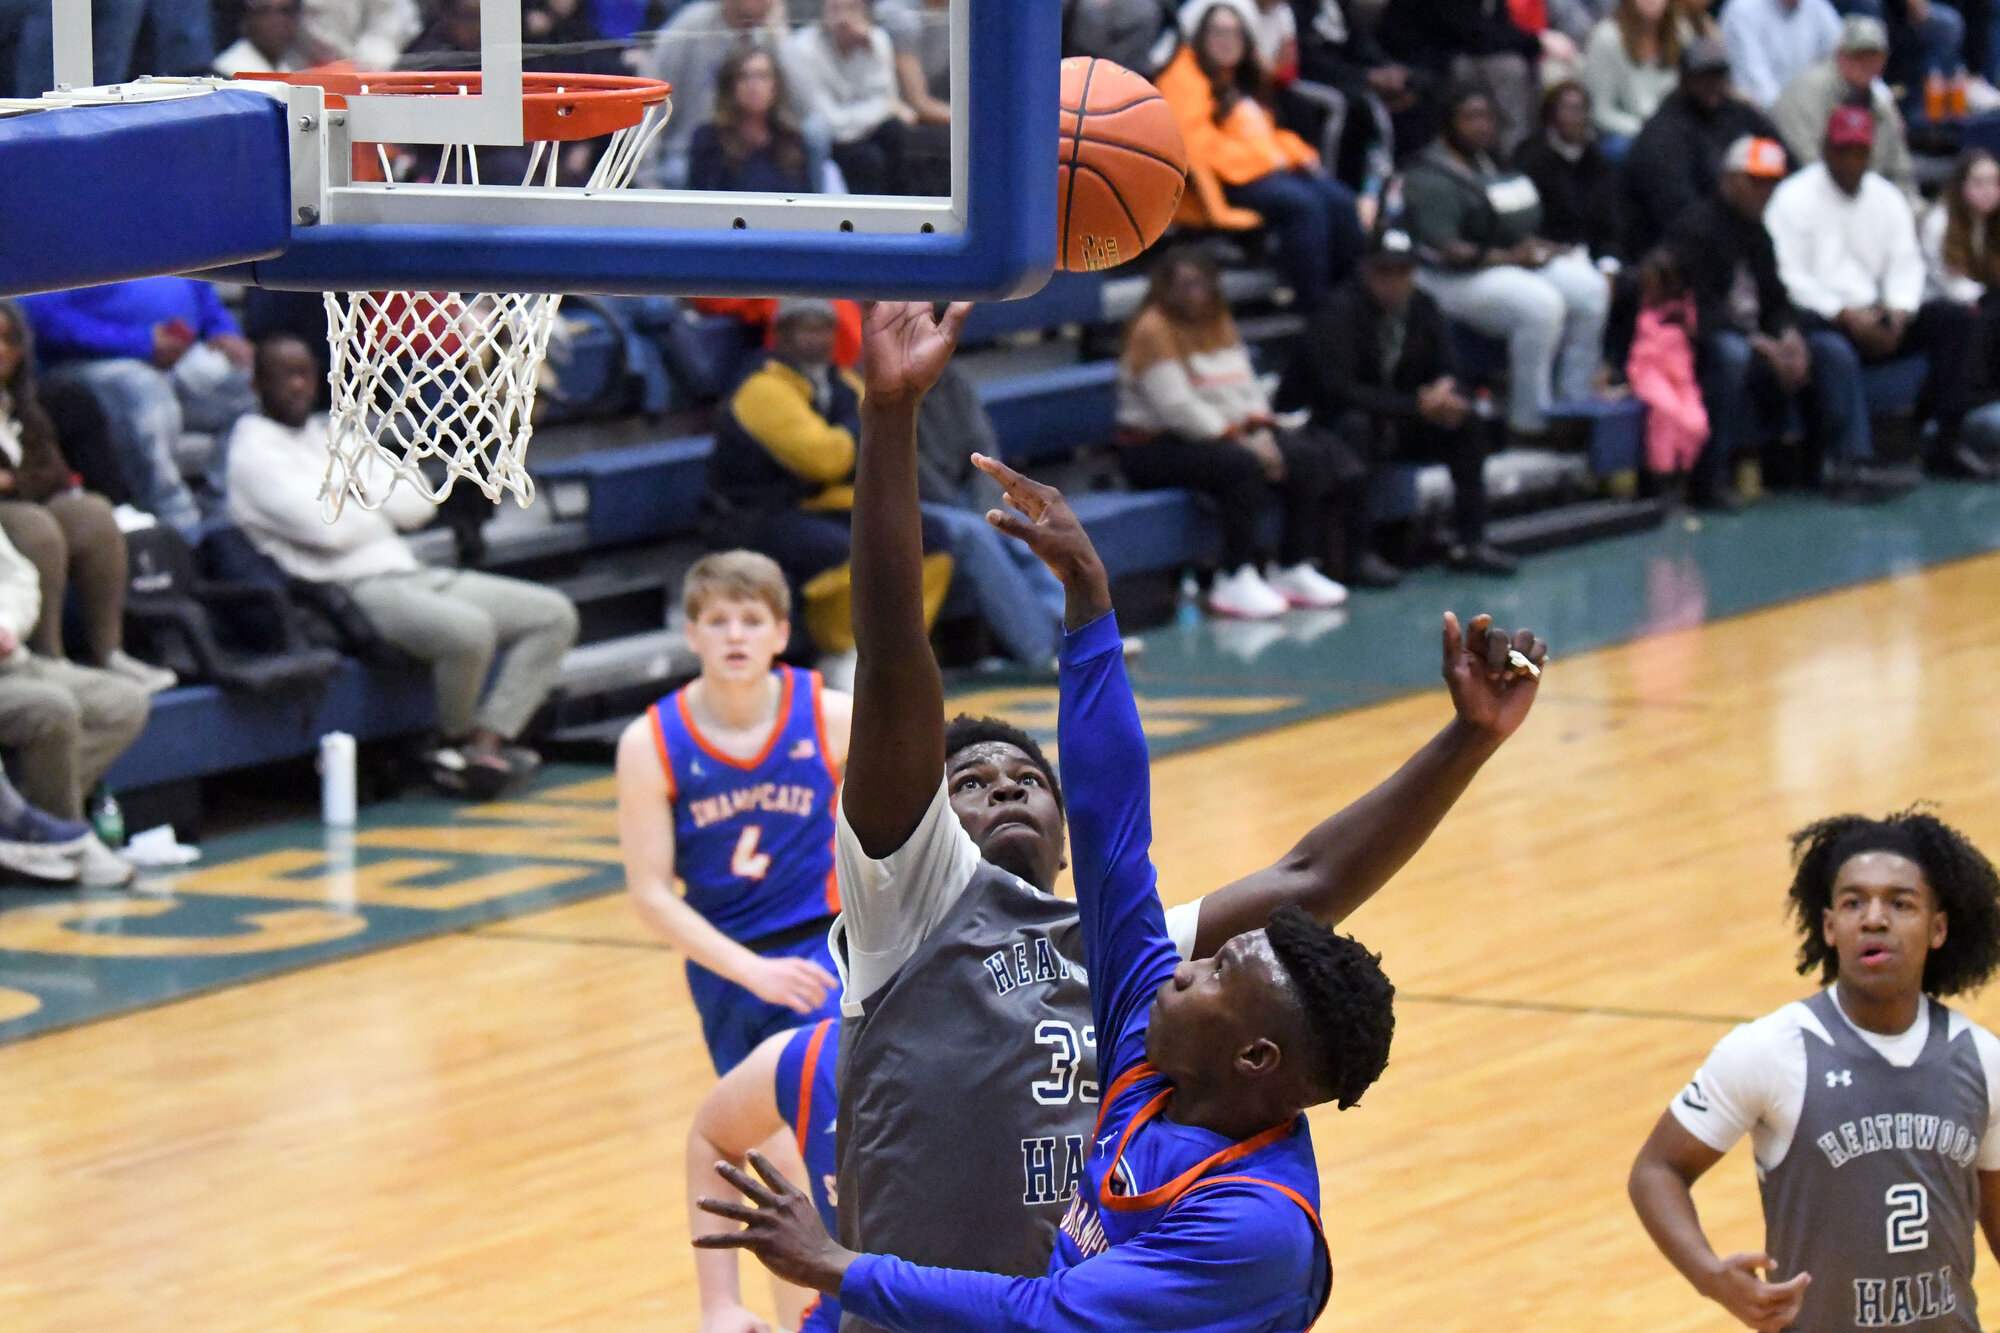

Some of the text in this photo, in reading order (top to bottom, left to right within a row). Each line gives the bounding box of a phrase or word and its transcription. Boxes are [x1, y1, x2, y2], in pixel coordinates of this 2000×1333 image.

[730, 824, 772, 882] 4
[1885, 1182, 1929, 1254] 2
[1853, 1264, 1957, 1328] HALL
